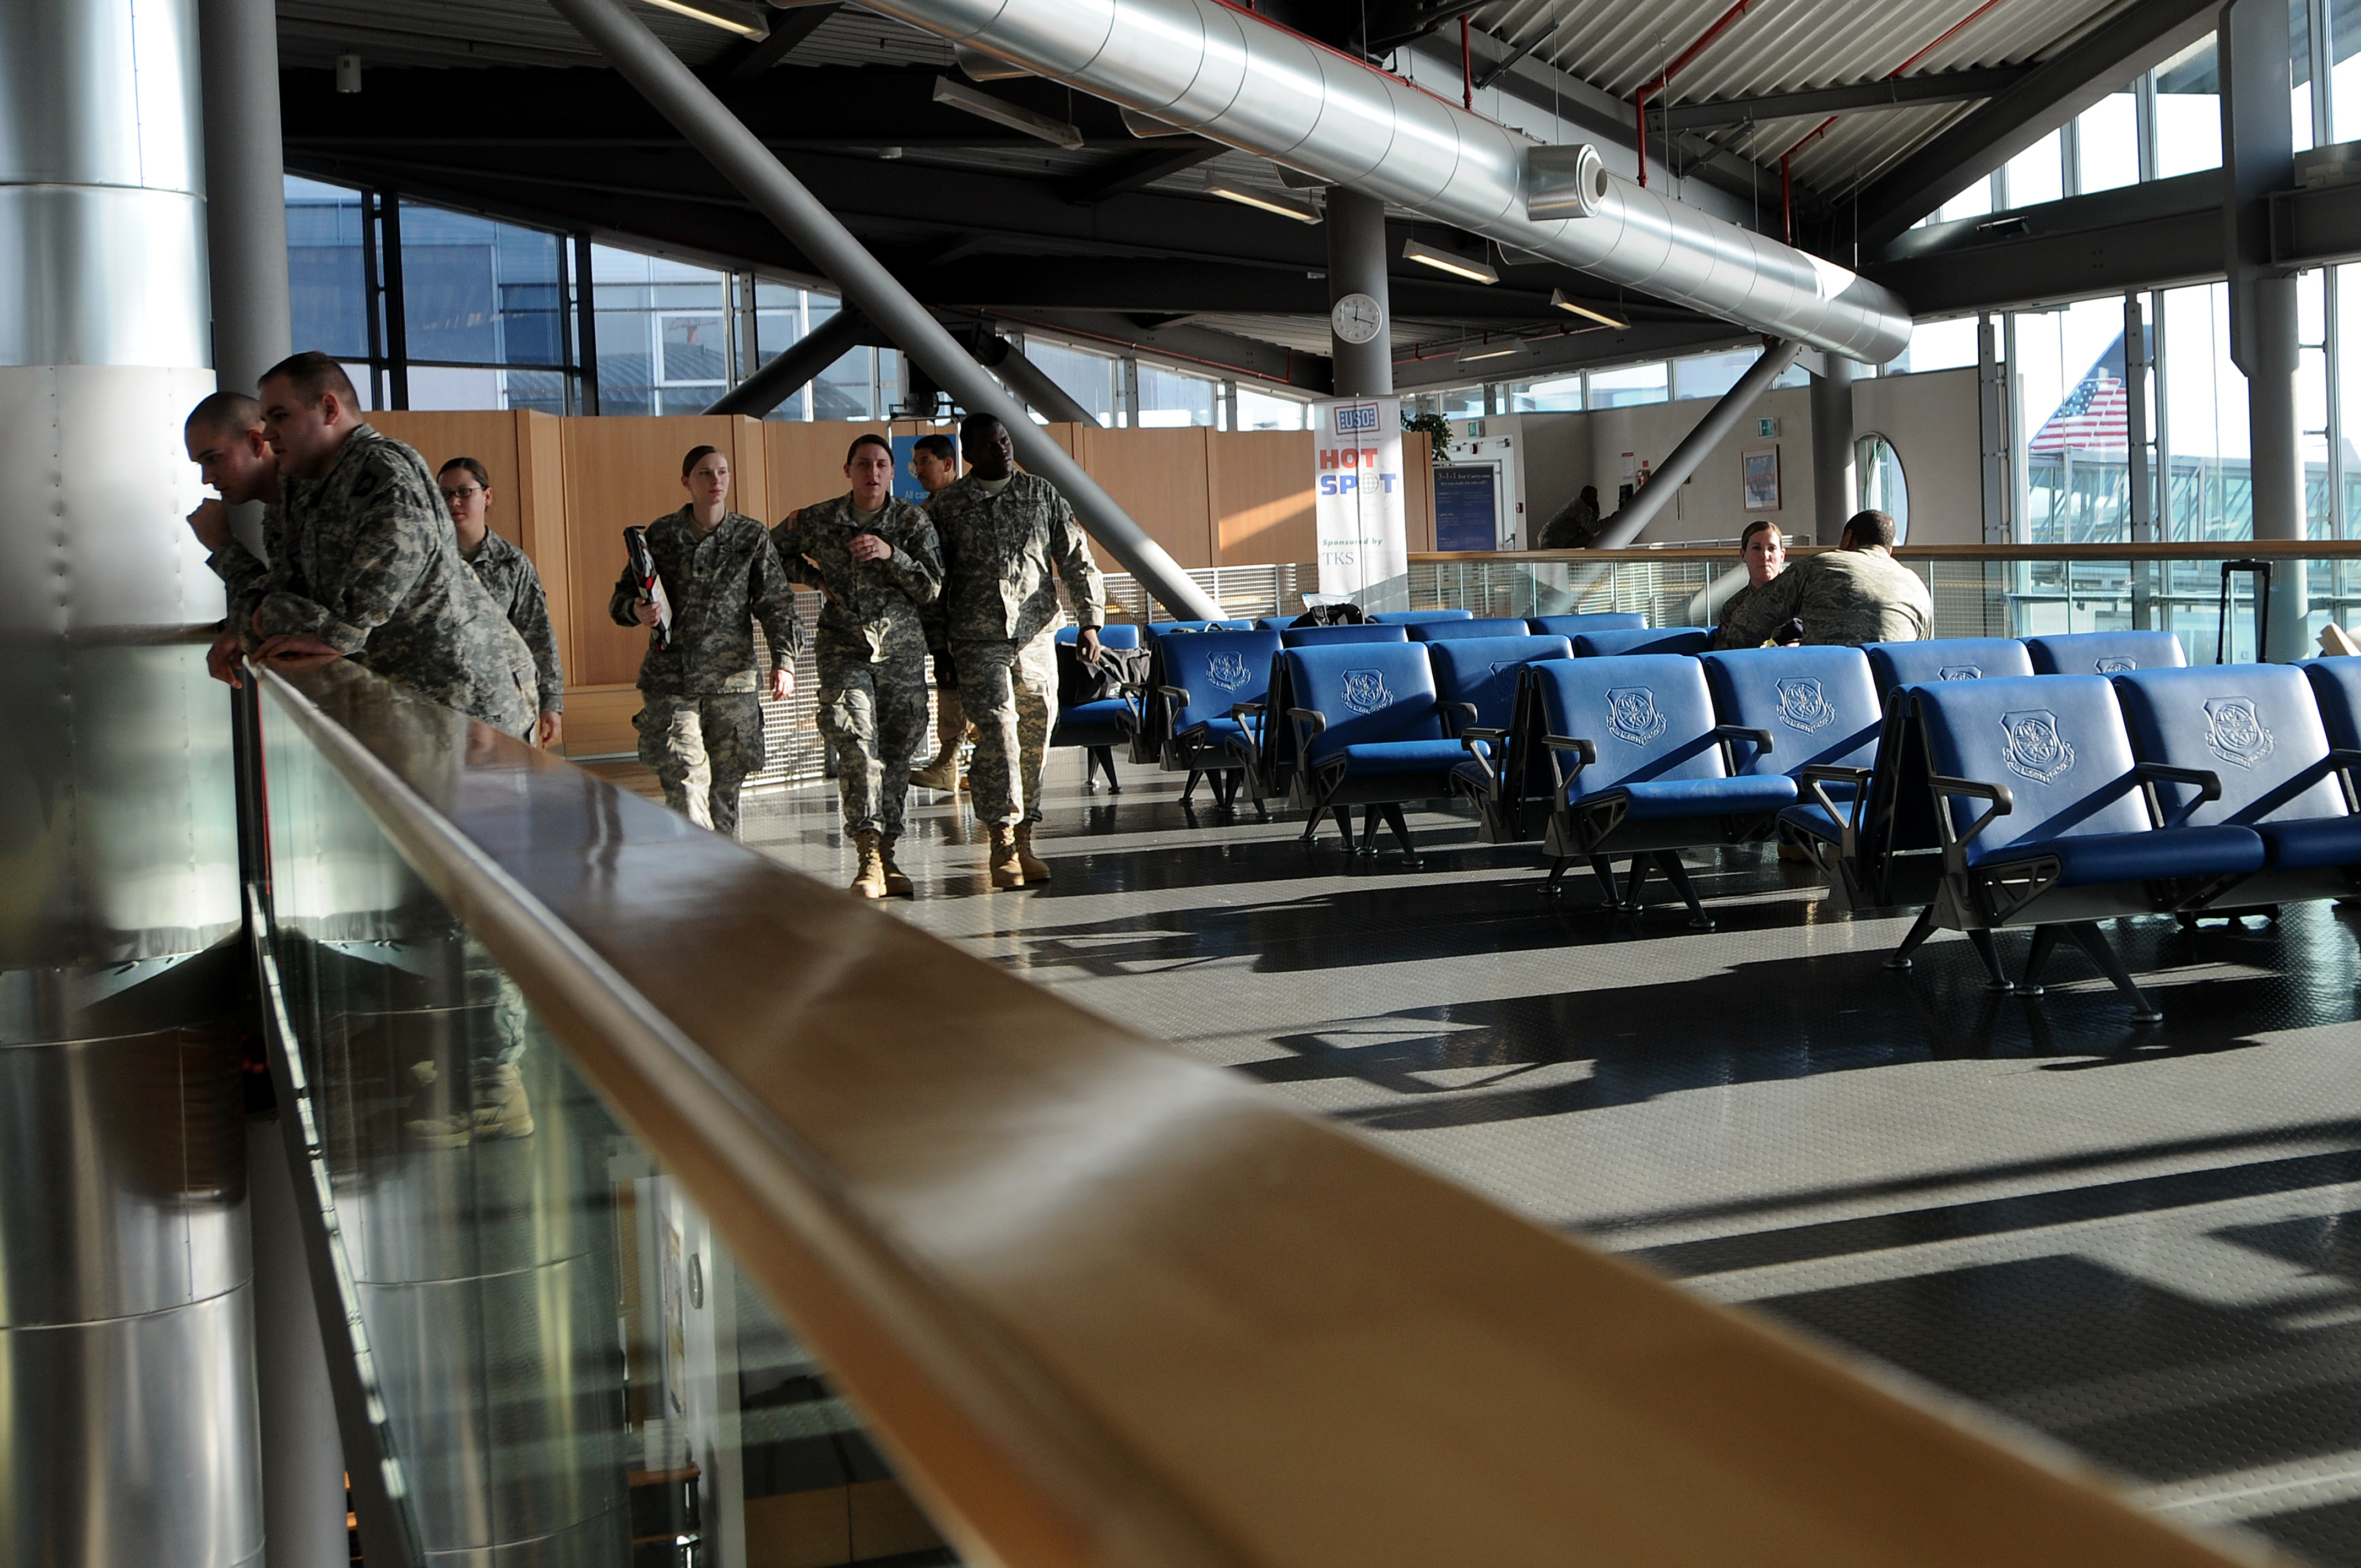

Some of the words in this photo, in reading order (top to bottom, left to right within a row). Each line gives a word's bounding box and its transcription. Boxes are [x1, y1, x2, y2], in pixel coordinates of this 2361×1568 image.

[1345, 410, 1369, 428] USO
[1320, 448, 1378, 469] HOT
[905, 491, 913, 499] All
[1372, 537, 1383, 546] by
[1322, 552, 1354, 565] TKS
